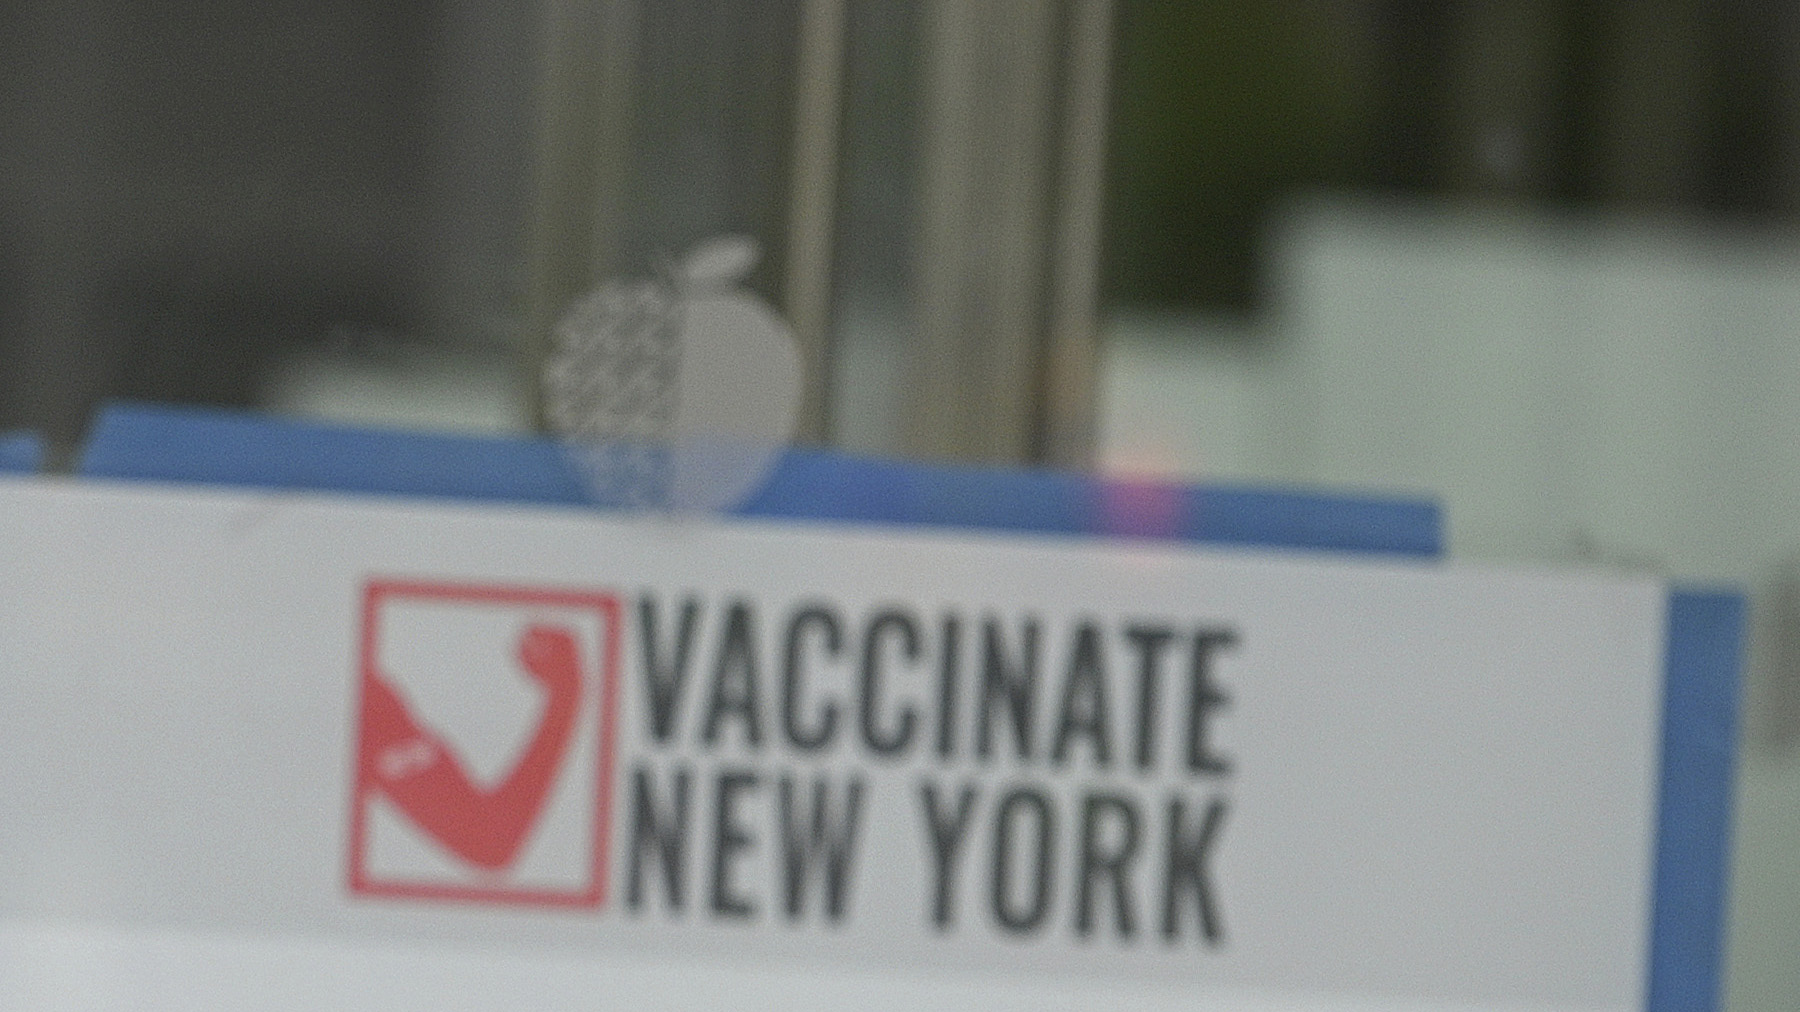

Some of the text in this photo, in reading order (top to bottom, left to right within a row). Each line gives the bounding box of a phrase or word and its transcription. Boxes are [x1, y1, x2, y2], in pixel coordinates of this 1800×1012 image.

[637, 592, 1240, 777] VACCINATE
[624, 763, 1230, 946] NEW YORK
